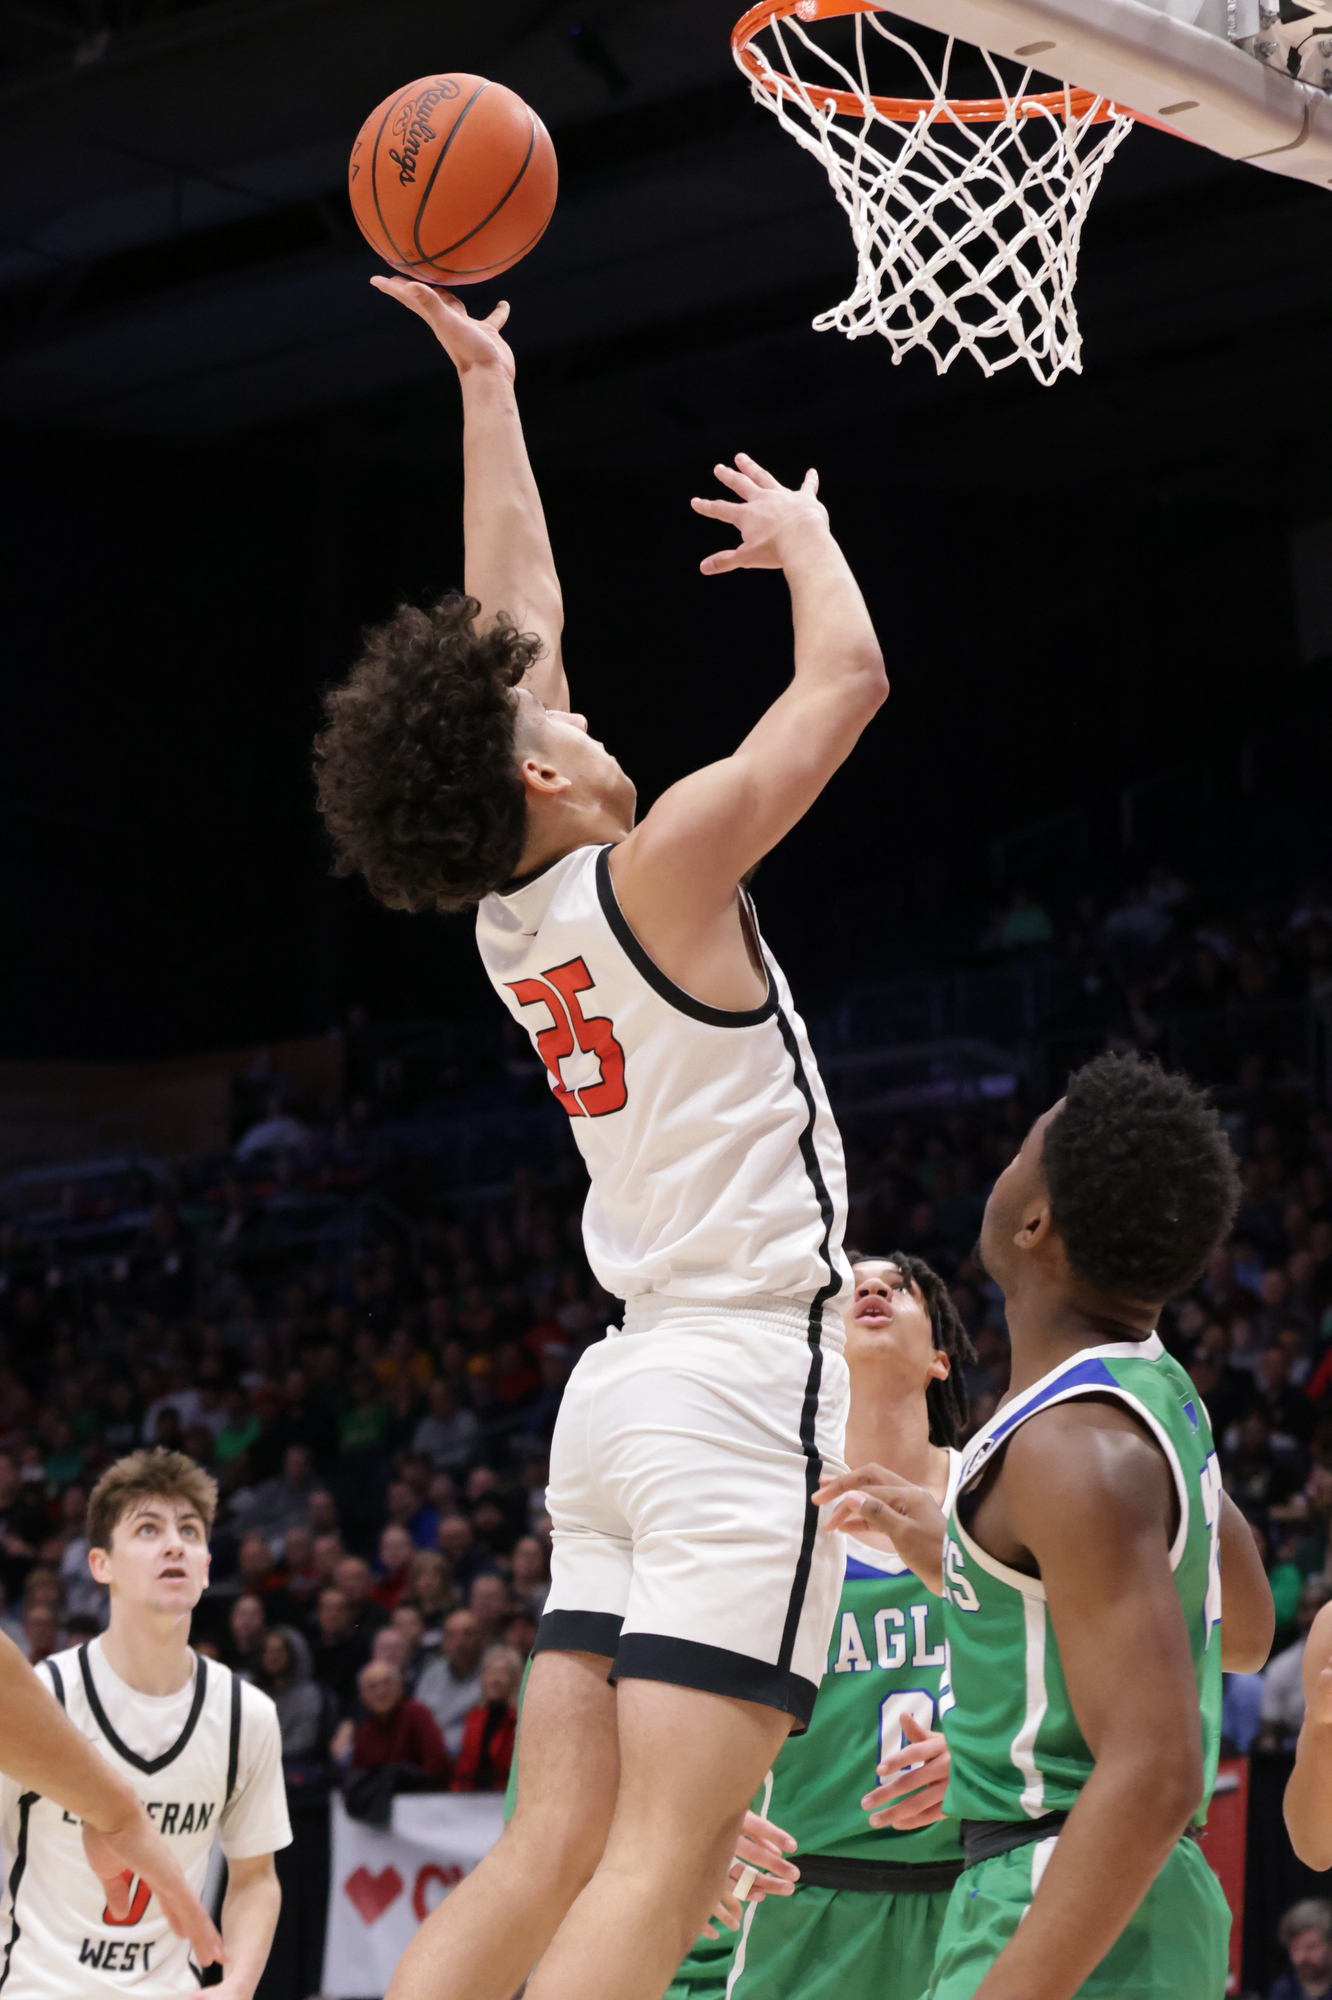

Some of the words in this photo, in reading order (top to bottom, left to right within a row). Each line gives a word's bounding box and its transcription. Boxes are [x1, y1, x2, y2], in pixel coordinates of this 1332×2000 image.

[389, 78, 461, 187] Rawlings
[502, 955, 628, 1118] 25
[824, 1604, 945, 1675] AGL
[78, 1938, 156, 1972] WEST
